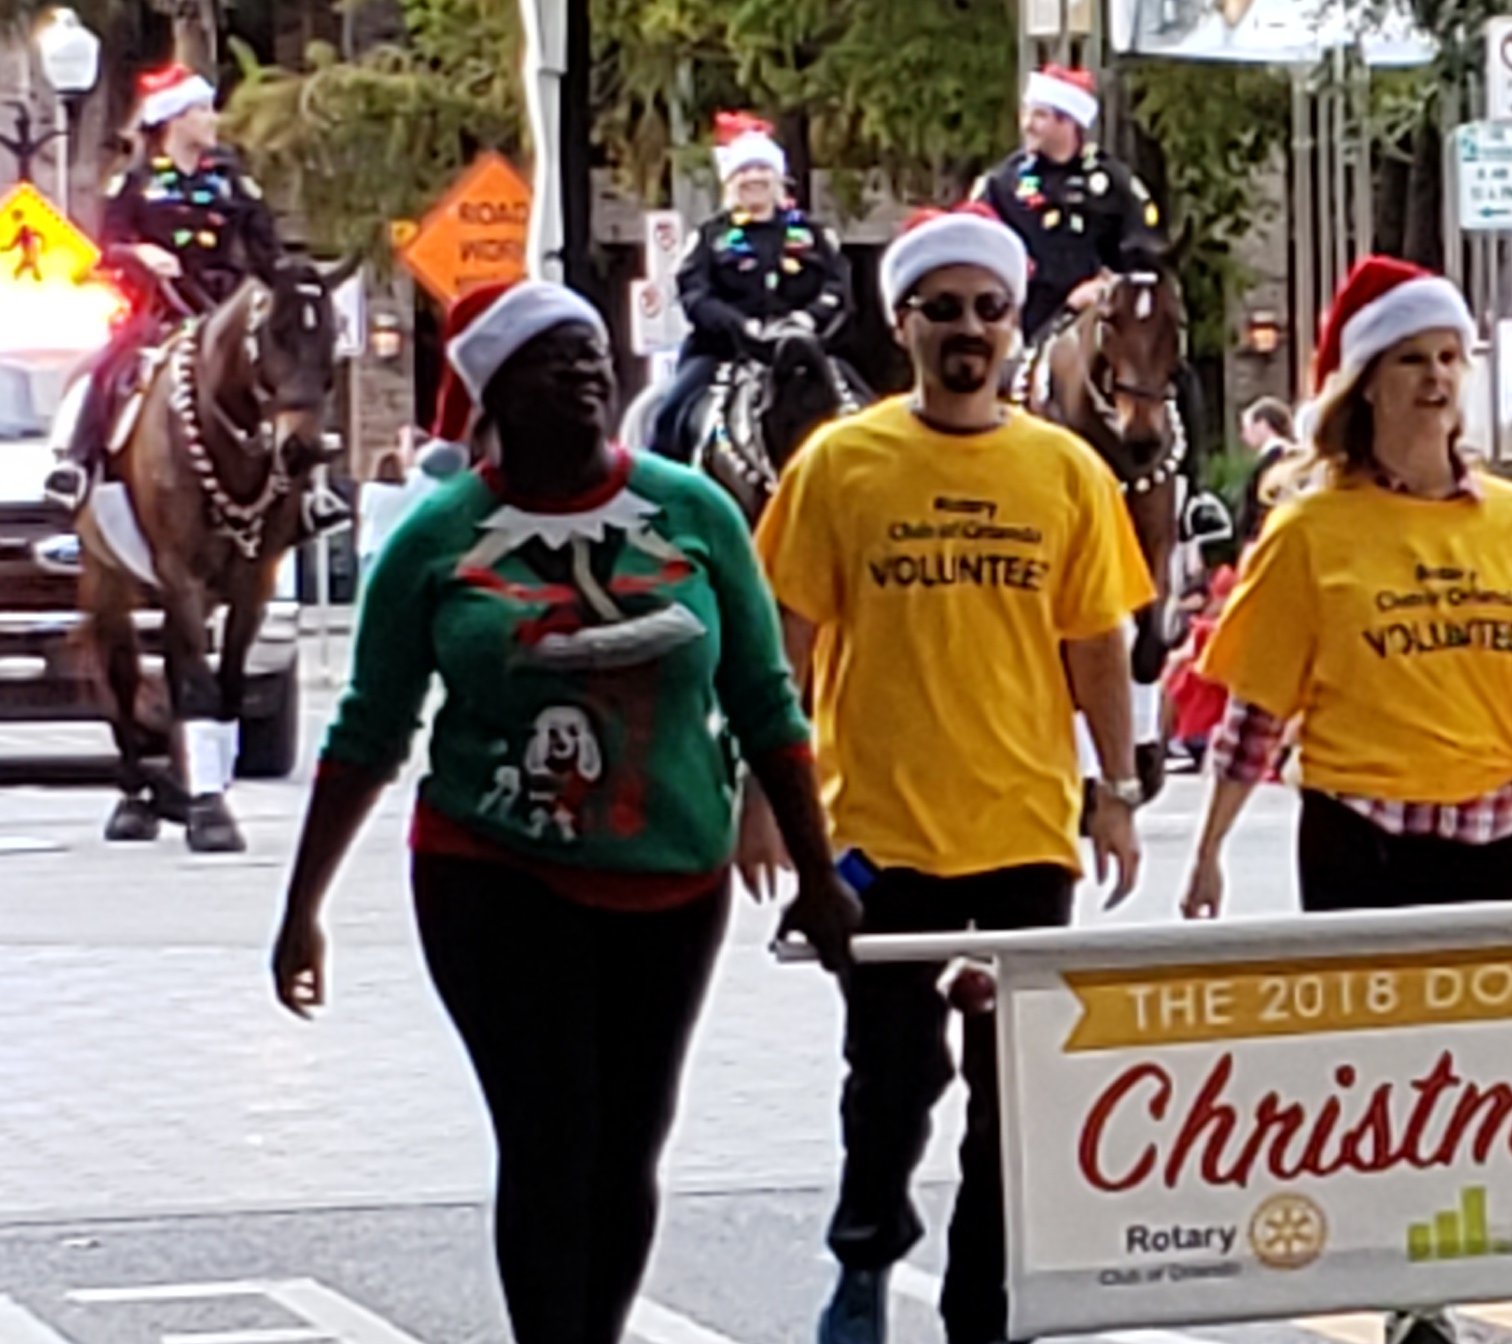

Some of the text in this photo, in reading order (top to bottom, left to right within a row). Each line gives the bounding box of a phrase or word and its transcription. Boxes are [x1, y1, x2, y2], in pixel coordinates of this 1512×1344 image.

[1129, 980, 1234, 1032] THE
[1258, 973, 1399, 1023] 2018
[1126, 1223, 1237, 1255] Rotary
